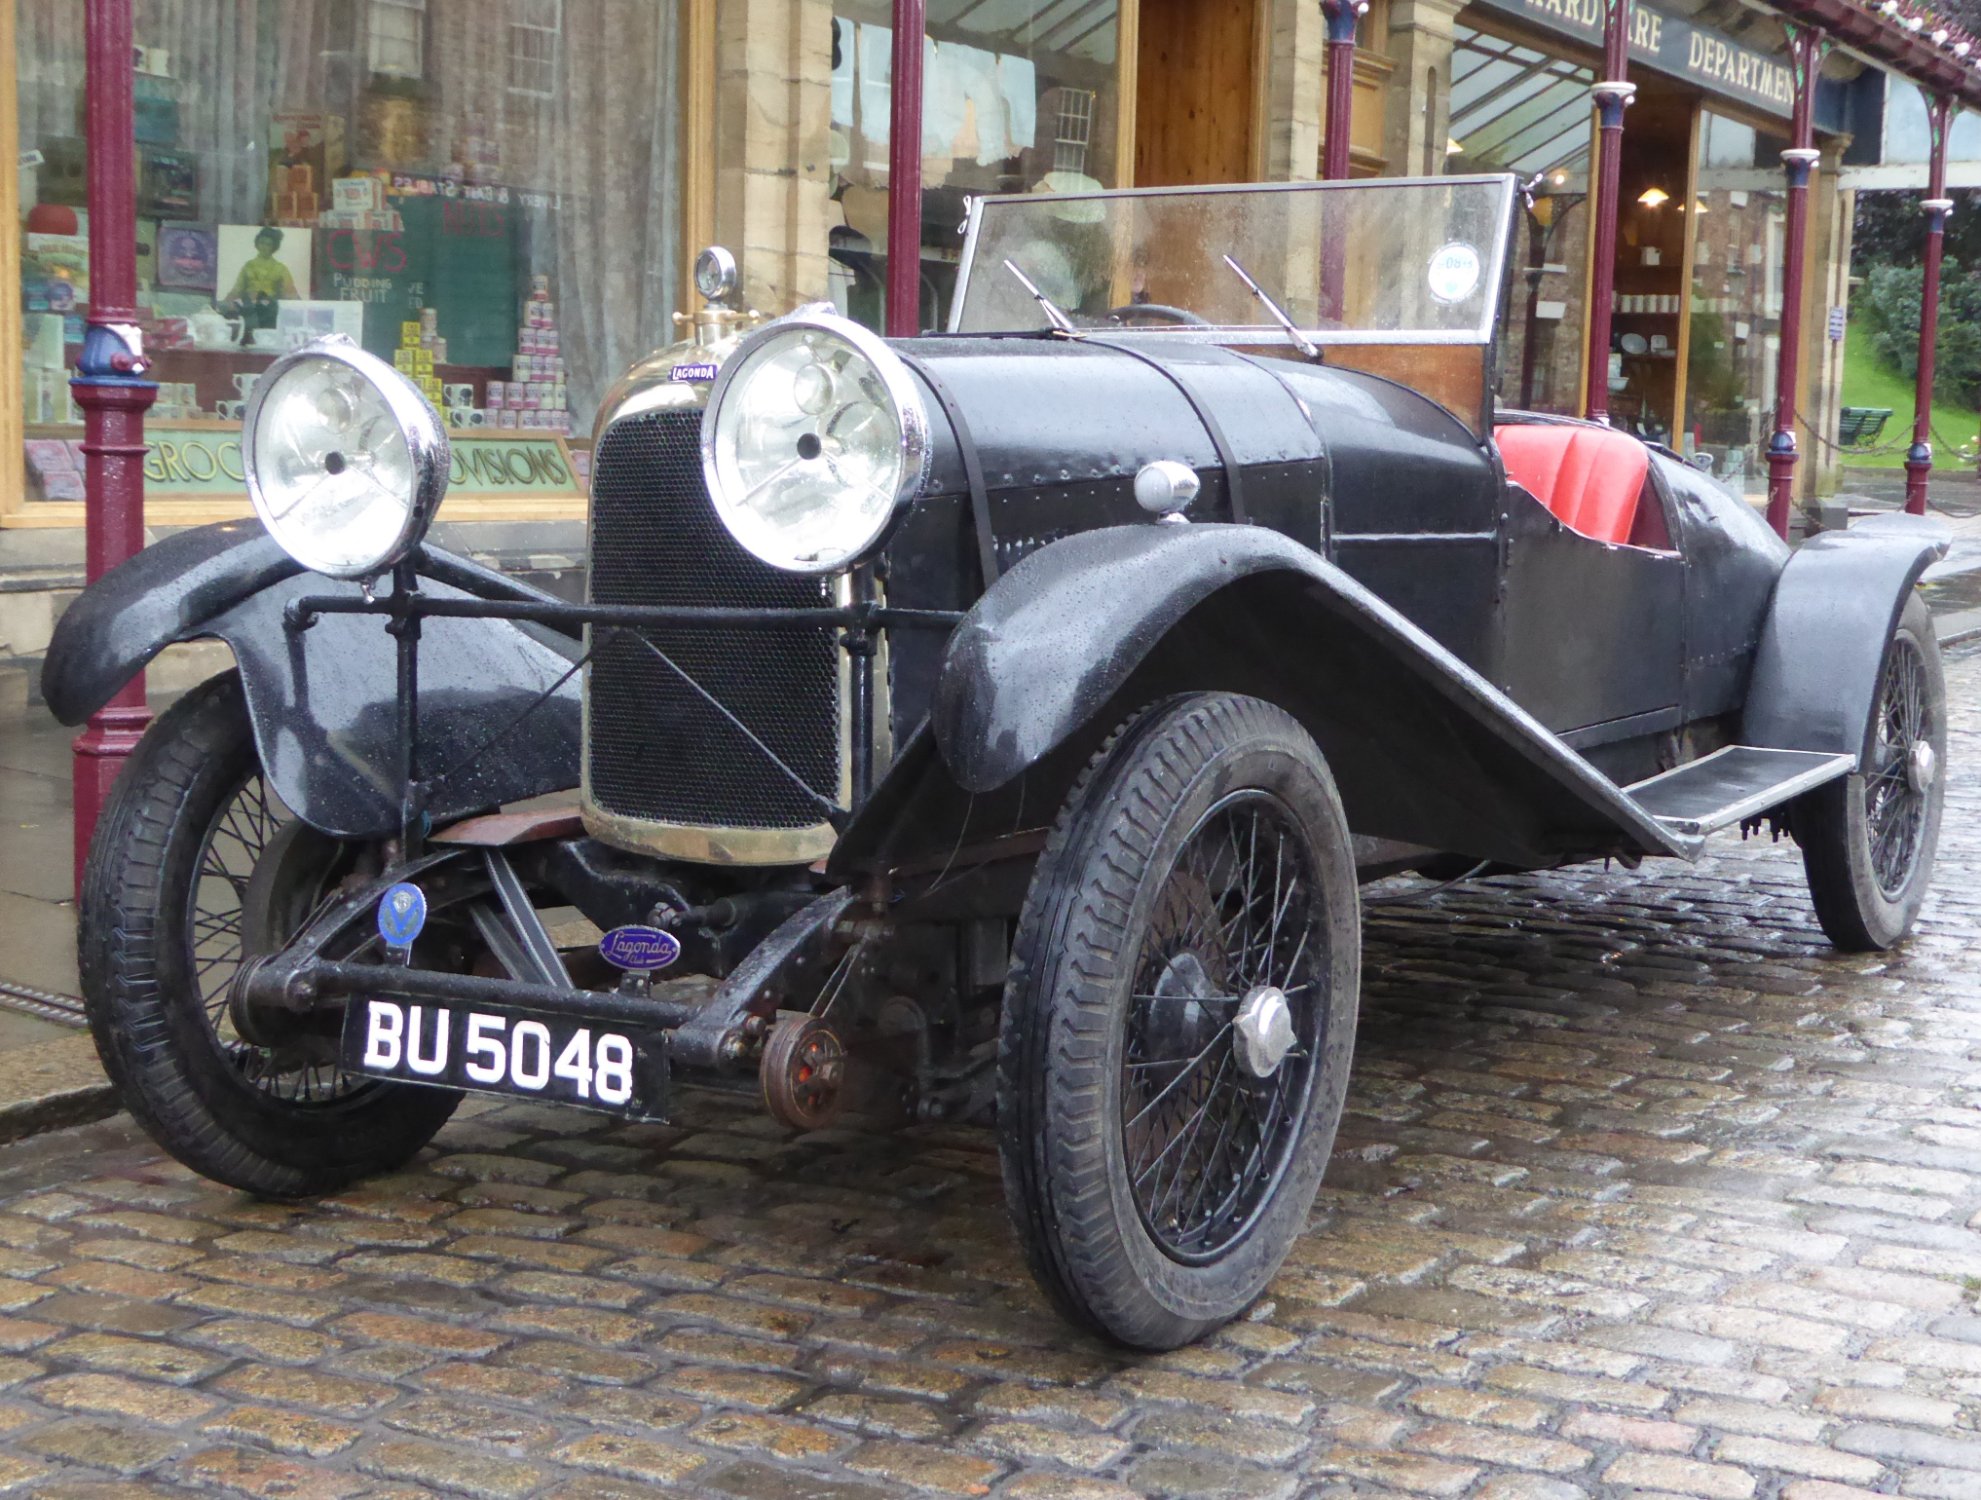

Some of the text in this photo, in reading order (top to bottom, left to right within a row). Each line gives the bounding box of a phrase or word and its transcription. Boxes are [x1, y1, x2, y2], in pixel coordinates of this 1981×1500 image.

[1688, 31, 1795, 105] DEPARTMEN
[326, 228, 408, 273] CWS
[333, 272, 393, 289] PUDDING
[340, 287, 388, 303] FRUIT
[672, 366, 714, 380] LAGONDA
[144, 441, 247, 482] GROC
[606, 931, 672, 959] Lagonda
[364, 1000, 633, 1106] BU 5048
